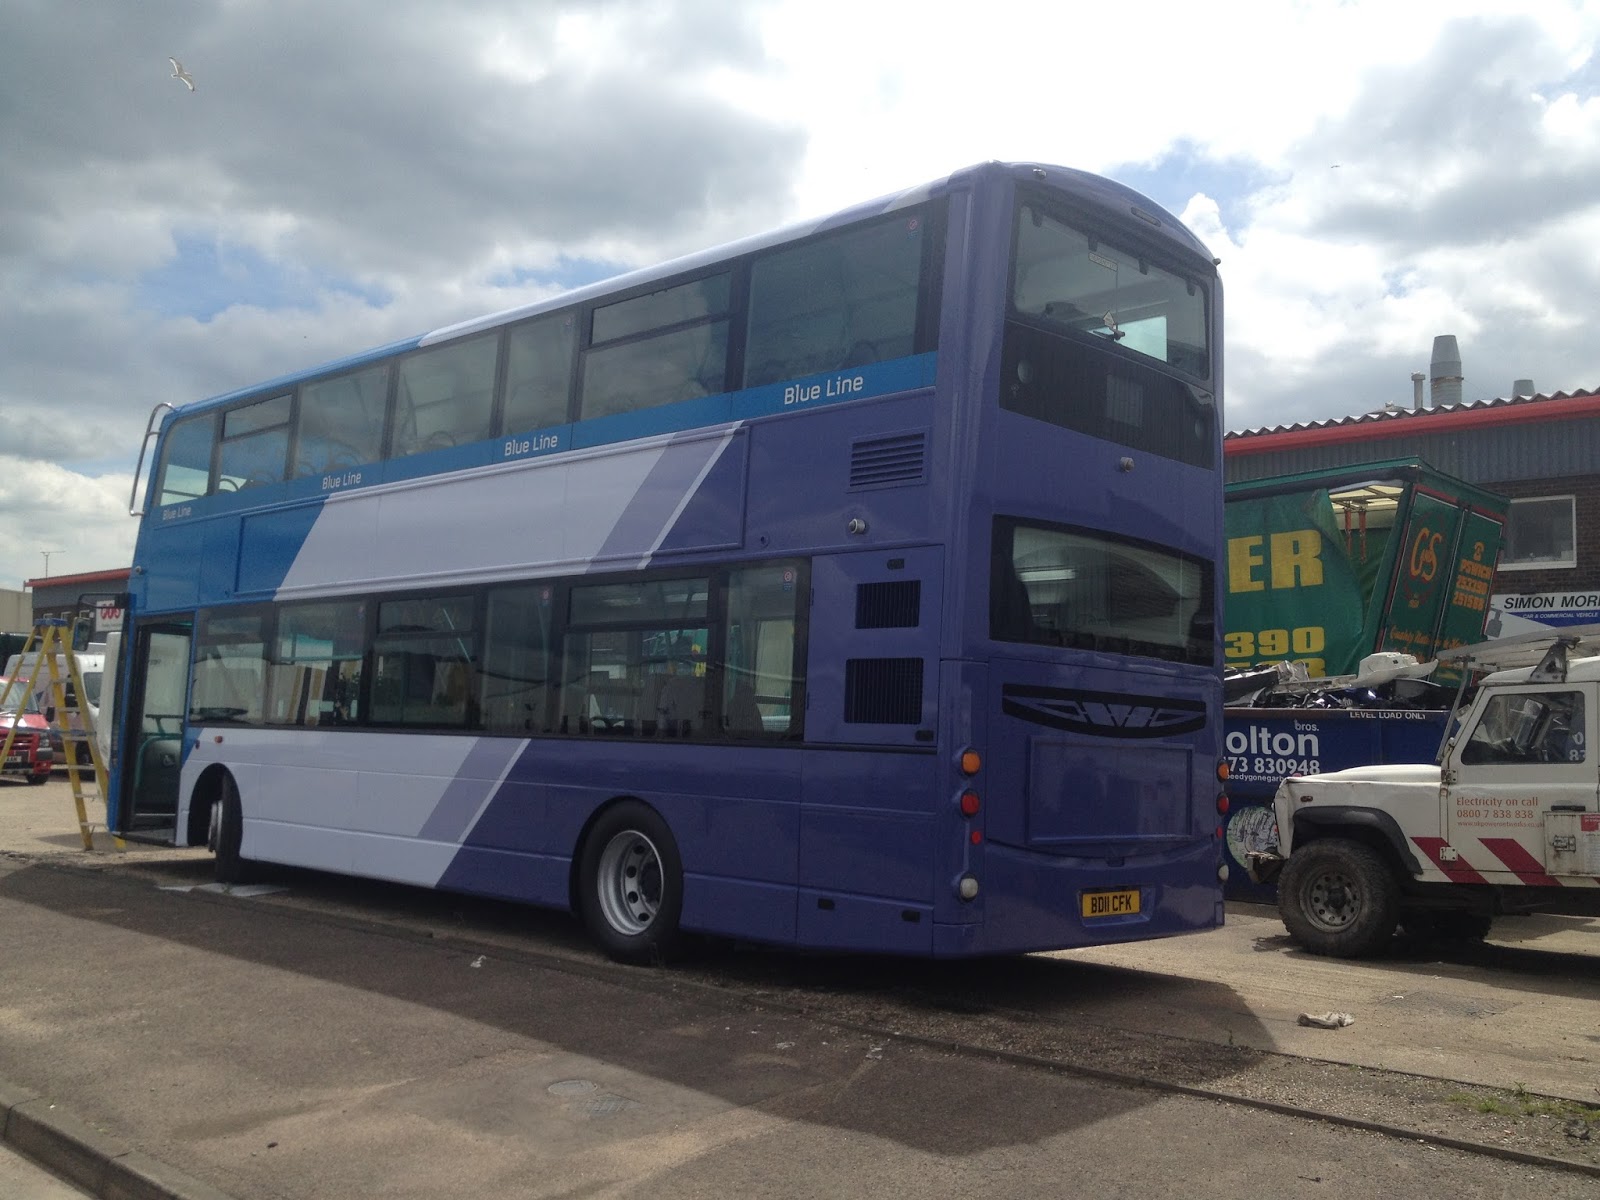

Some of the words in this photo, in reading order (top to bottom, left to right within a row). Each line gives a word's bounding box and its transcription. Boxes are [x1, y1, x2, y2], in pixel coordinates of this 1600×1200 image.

[784, 384, 820, 405] Blue
[826, 376, 864, 397] Line
[504, 439, 530, 456] Blue
[532, 435, 558, 451] Line
[322, 475, 341, 490] Blue
[342, 472, 362, 487] Line
[1227, 529, 1324, 594] ER
[1503, 596, 1555, 609] SIMON
[1560, 595, 1600, 608] MOR
[1224, 626, 1325, 658] 390
[1349, 711, 1377, 719] LEVEL
[1378, 711, 1402, 719] LOAD
[1293, 719, 1320, 732] bros.
[1225, 725, 1319, 757] olton
[1223, 756, 1249, 773] 73
[1253, 757, 1320, 776] 830948
[1456, 797, 1503, 808] Electricity
[1521, 796, 1538, 806] call
[1456, 809, 1481, 818] 0800
[1483, 809, 1490, 818] 7
[1492, 809, 1512, 818] 838
[1514, 809, 1534, 819] 838
[1112, 894, 1132, 912] CFK
